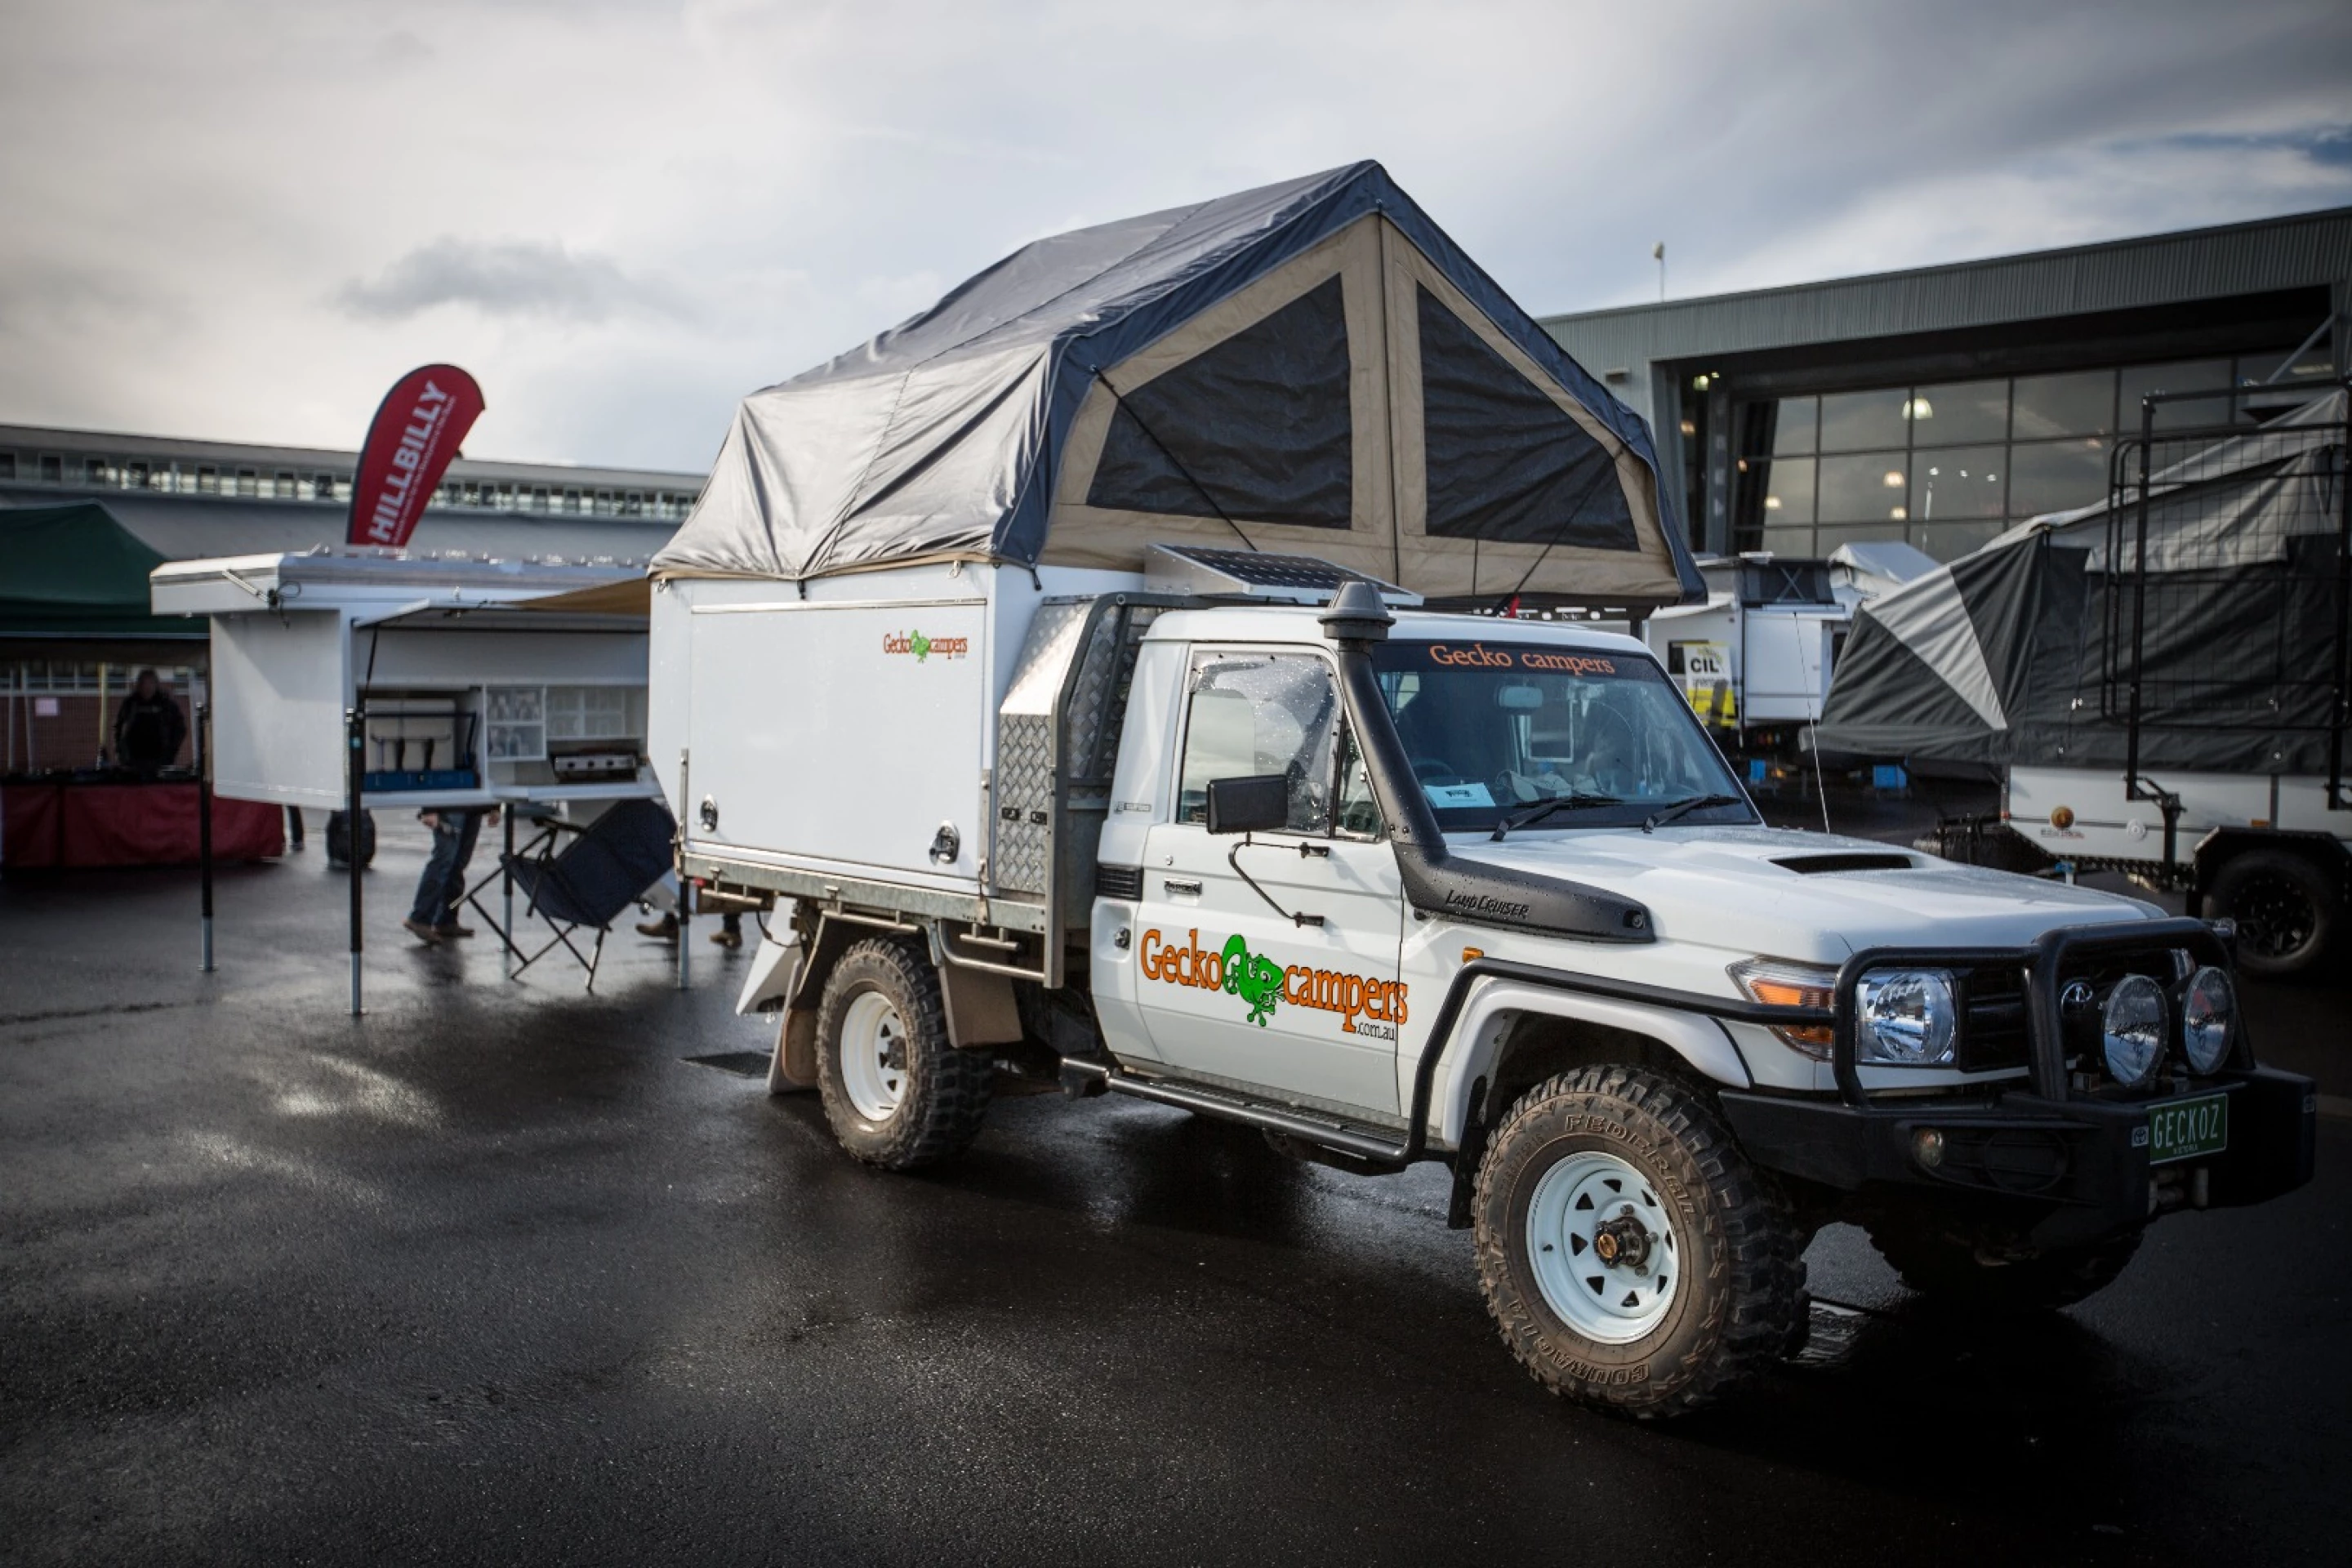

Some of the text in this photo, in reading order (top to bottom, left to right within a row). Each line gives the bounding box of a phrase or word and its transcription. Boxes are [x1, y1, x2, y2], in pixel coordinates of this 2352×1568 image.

[368, 380, 448, 542] HILLBILLY
[884, 630, 968, 660] Gecko campers
[1429, 643, 1615, 676] Gecko campers
[1690, 657, 1719, 673] CIL
[1140, 928, 1409, 1033] Gecko campers
[1356, 1022, 1395, 1041] .com.au
[2154, 1104, 2220, 1149] GECKOZ
[1565, 1114, 1696, 1226] FEDERAL
